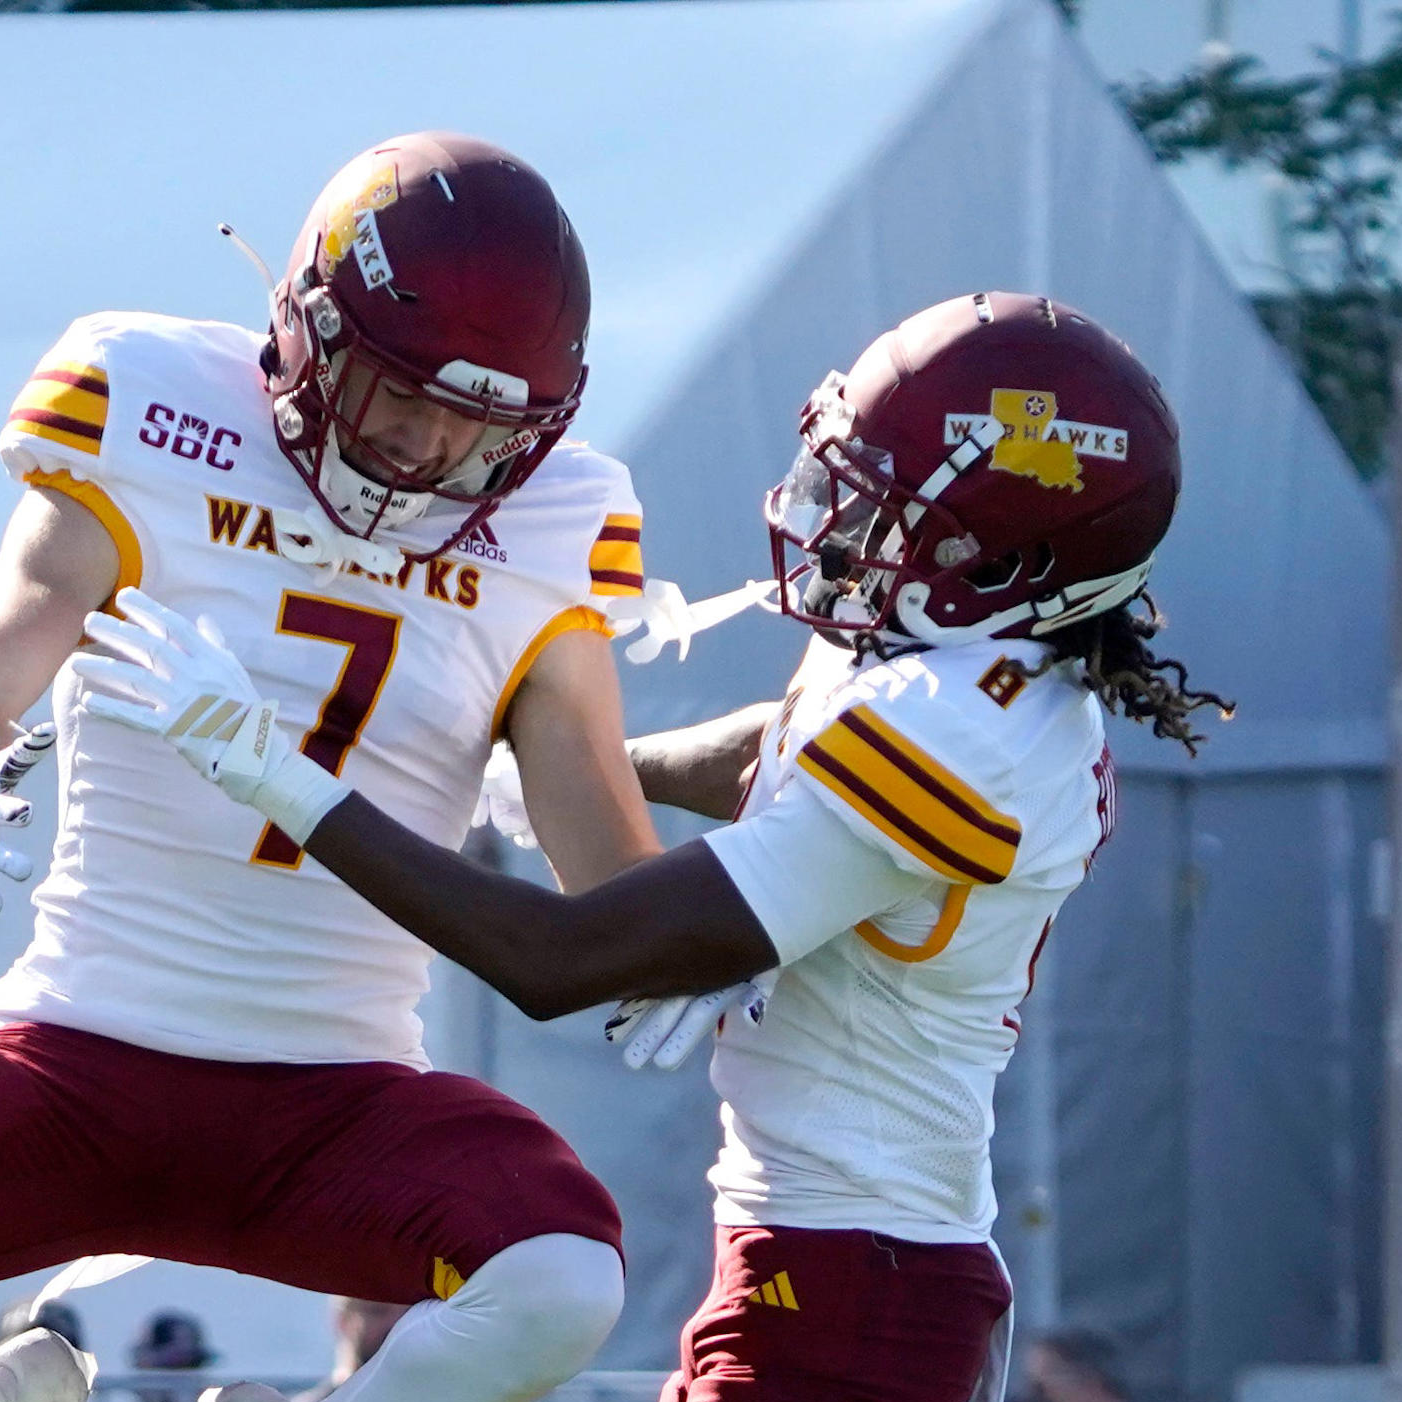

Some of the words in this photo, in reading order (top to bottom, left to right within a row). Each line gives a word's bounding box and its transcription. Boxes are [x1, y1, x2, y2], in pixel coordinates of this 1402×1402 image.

[139, 401, 243, 472] SBC
[482, 427, 541, 466] Riddel
[950, 419, 1127, 454] WRHAWKS
[360, 485, 408, 509] Ridell
[453, 536, 509, 563] didas
[249, 587, 404, 871] 7
